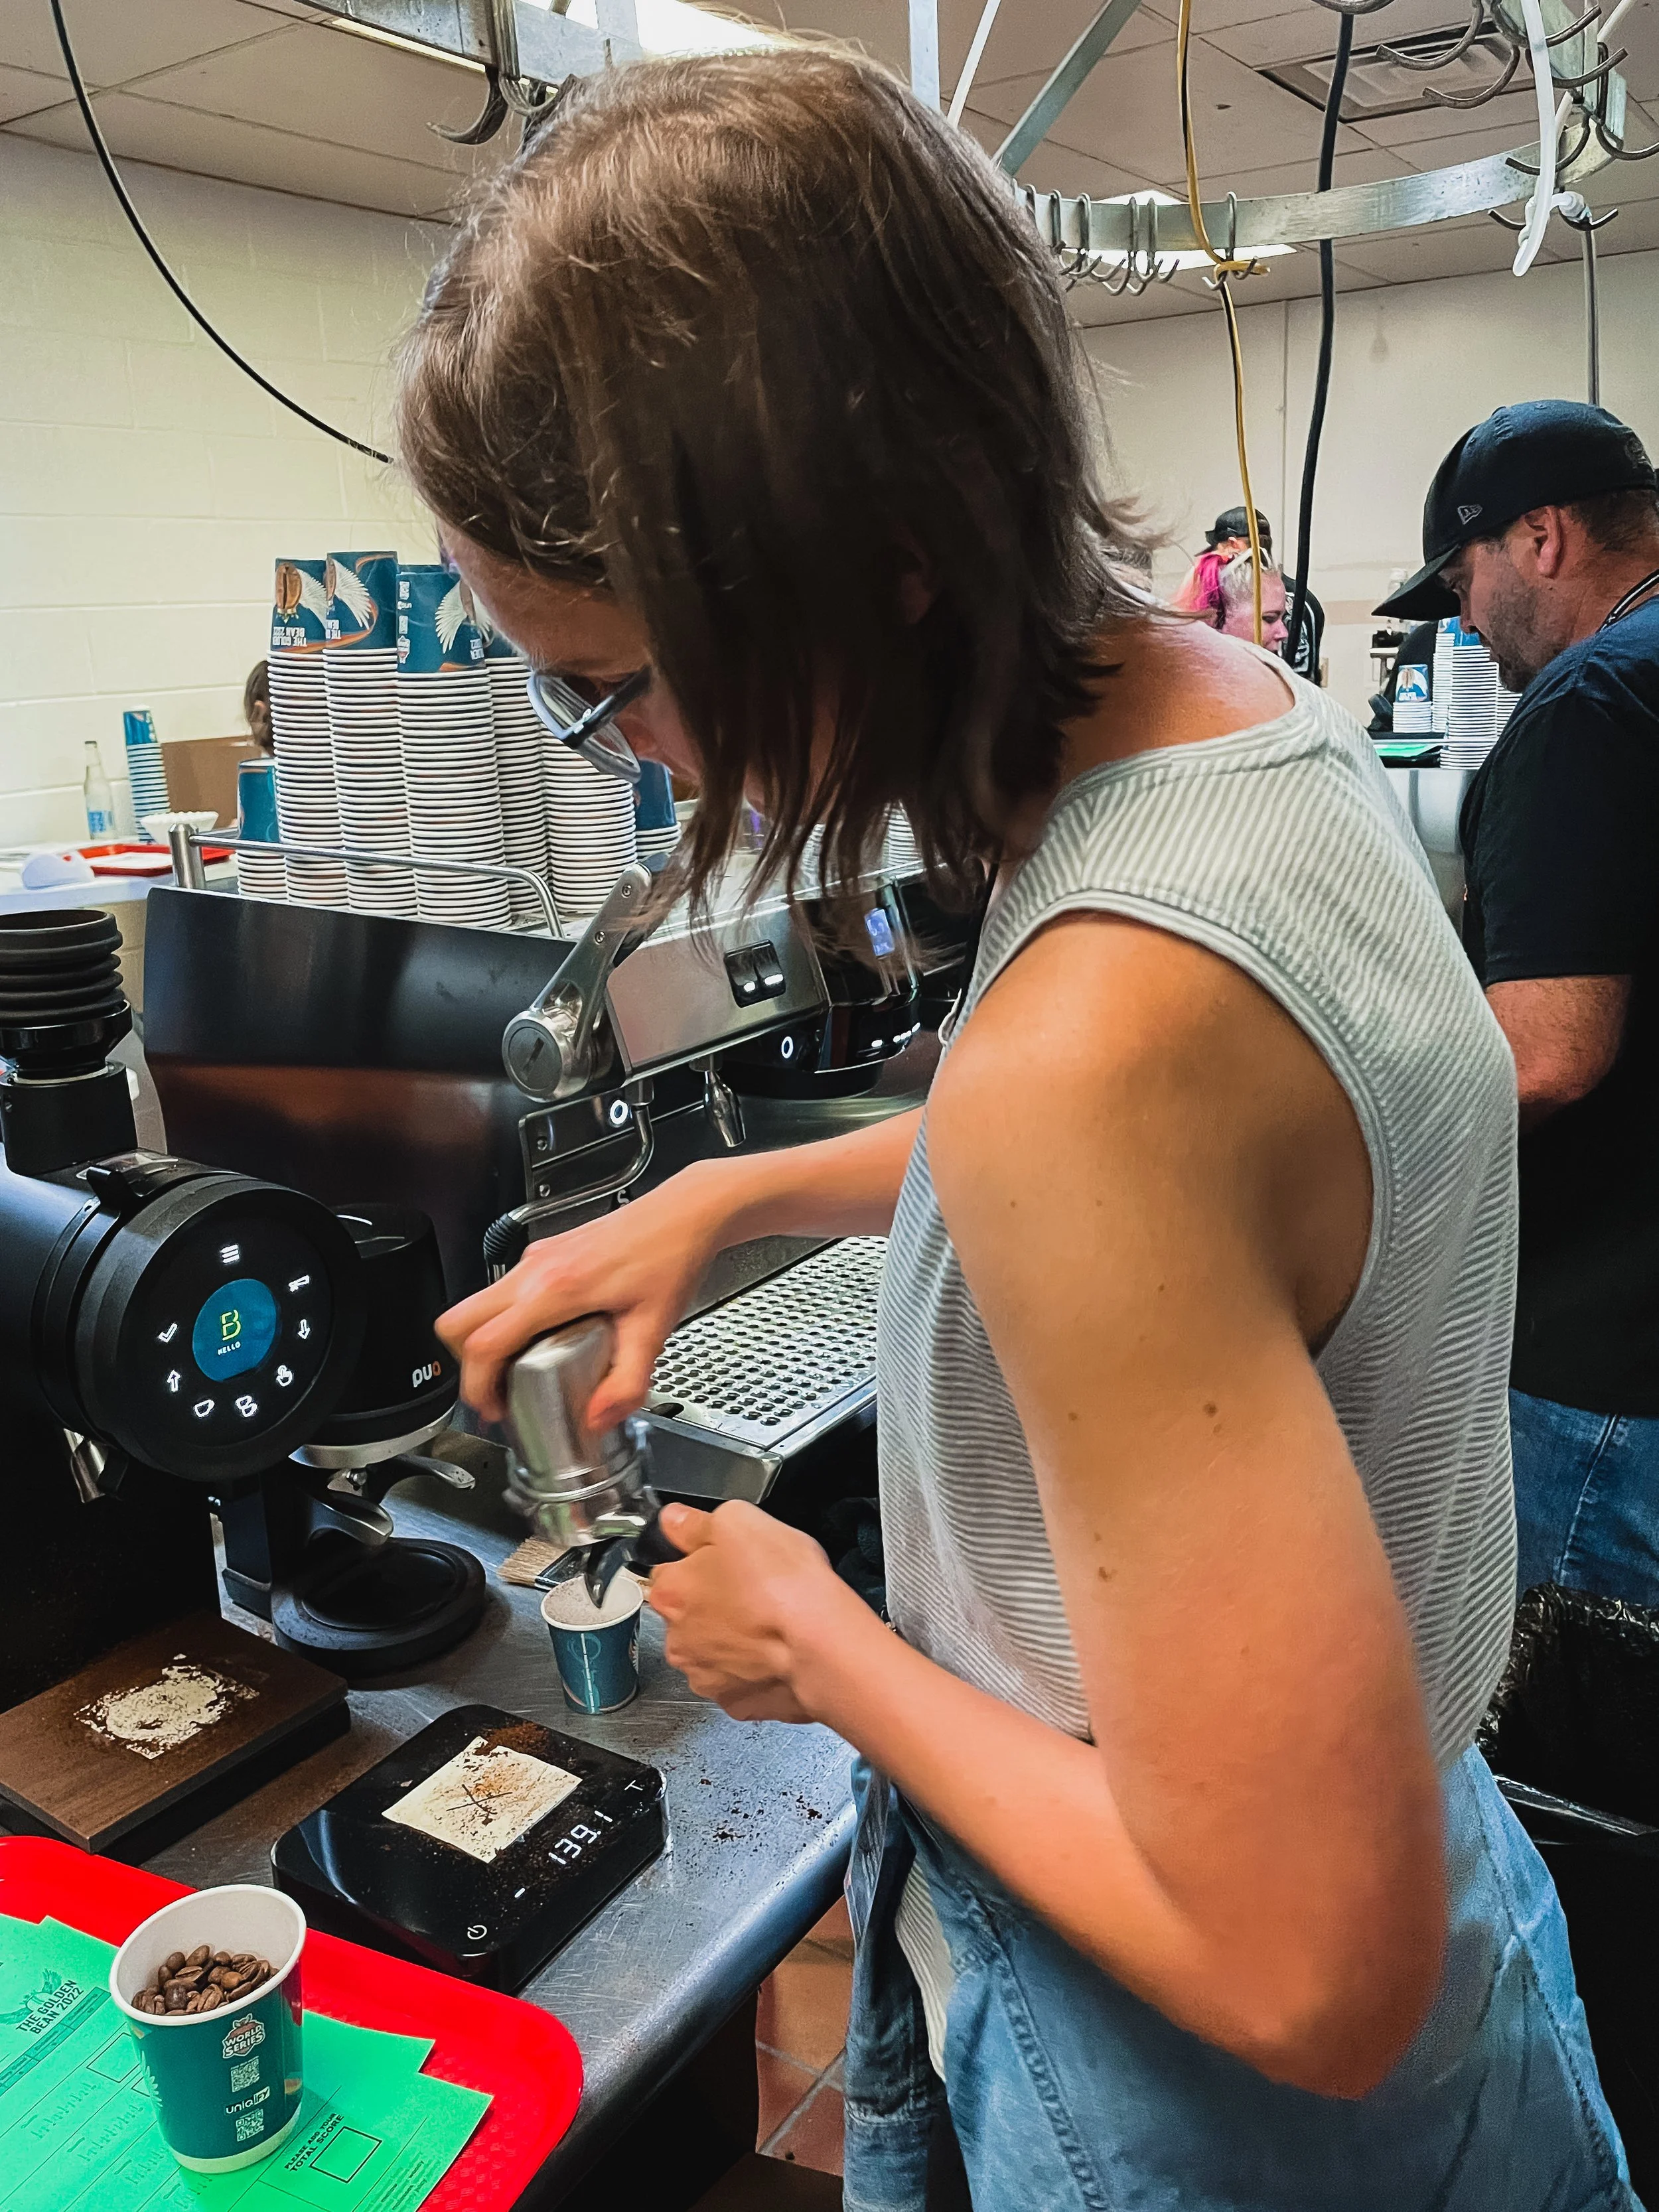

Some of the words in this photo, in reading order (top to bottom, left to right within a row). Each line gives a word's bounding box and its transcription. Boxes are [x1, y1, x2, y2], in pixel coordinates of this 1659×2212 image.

[218, 1341, 241, 1355] HELLO
[16, 2012, 42, 2032] THE
[37, 1980, 77, 2014] GOLDEN
[29, 2010, 60, 2034] BEAN
[56, 1987, 84, 2011] 2022
[224, 2032, 265, 2057] SERIES
[225, 2024, 262, 2047] WORLD
[284, 2145, 308, 2170] PLEASE
[308, 2131, 321, 2145] ADD
[289, 2146, 319, 2172] TOTAL
[316, 2114, 345, 2144] SCORE
